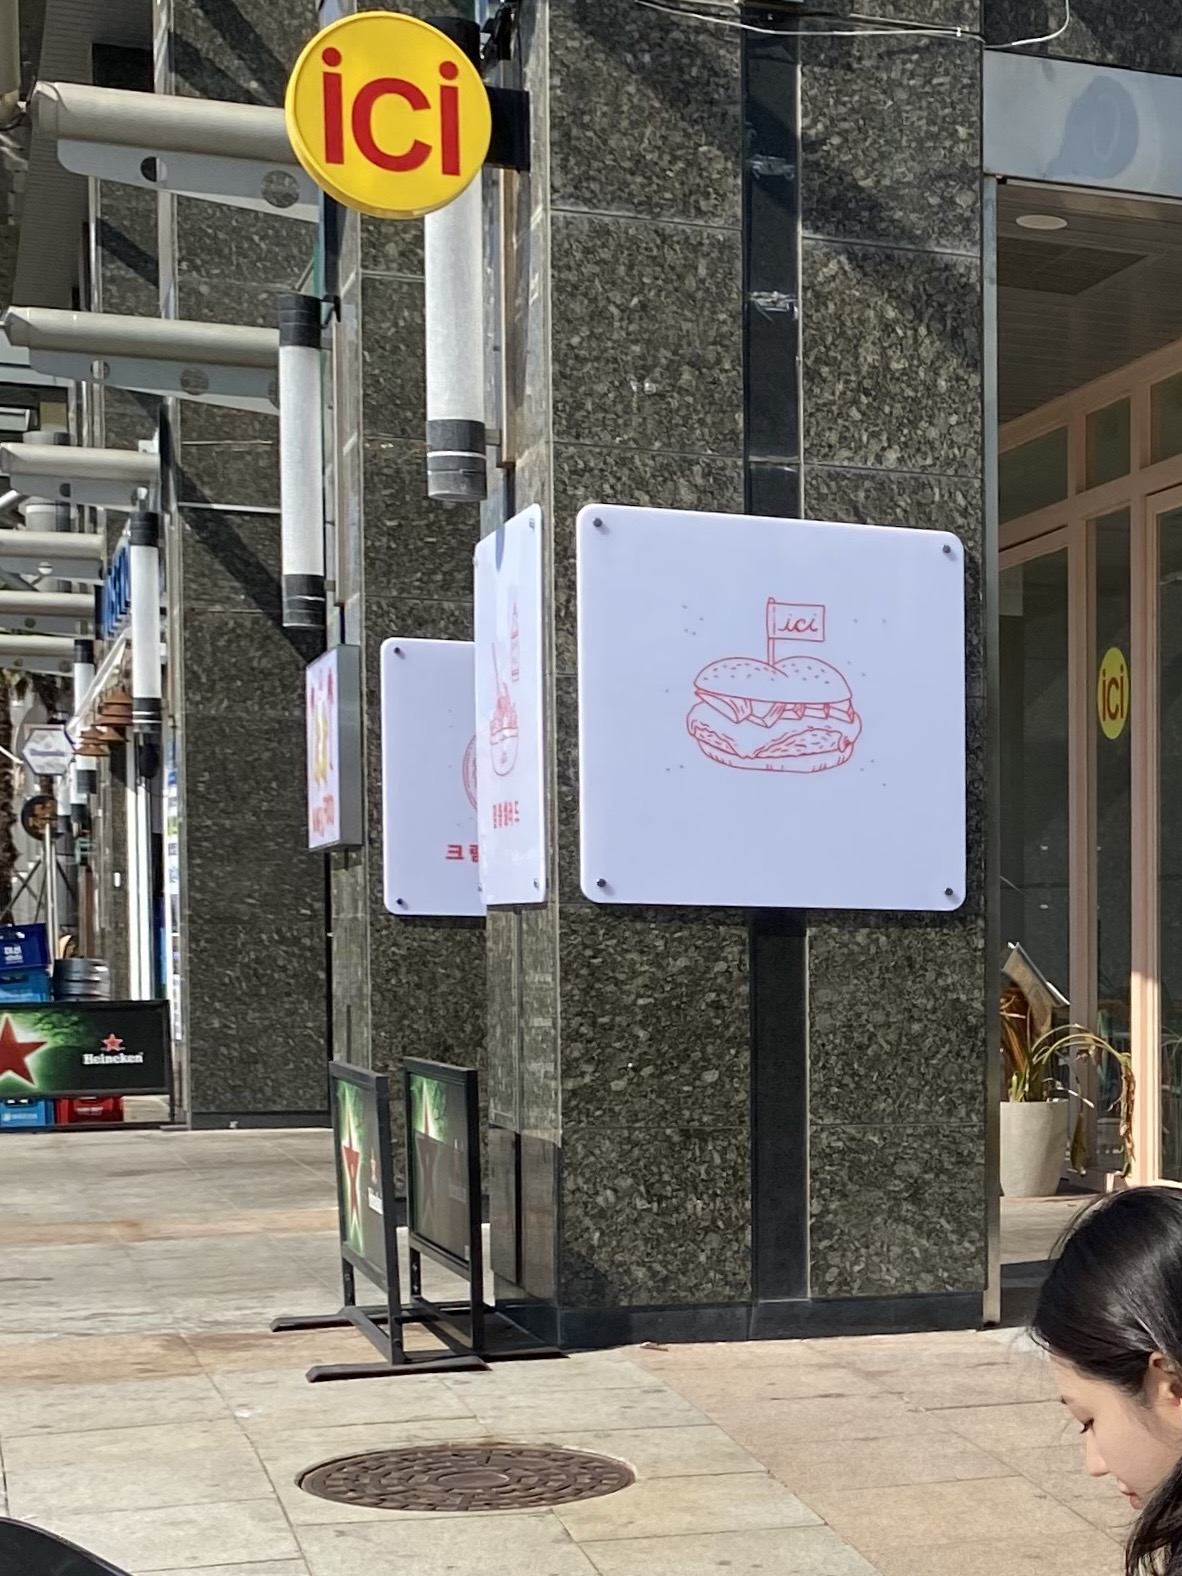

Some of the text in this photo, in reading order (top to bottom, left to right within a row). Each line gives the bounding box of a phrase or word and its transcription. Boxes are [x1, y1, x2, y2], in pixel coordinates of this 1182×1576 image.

[322, 47, 460, 176] ici
[777, 612, 819, 633] ici
[1102, 663, 1125, 723] ici
[83, 1052, 144, 1066] Heineken
